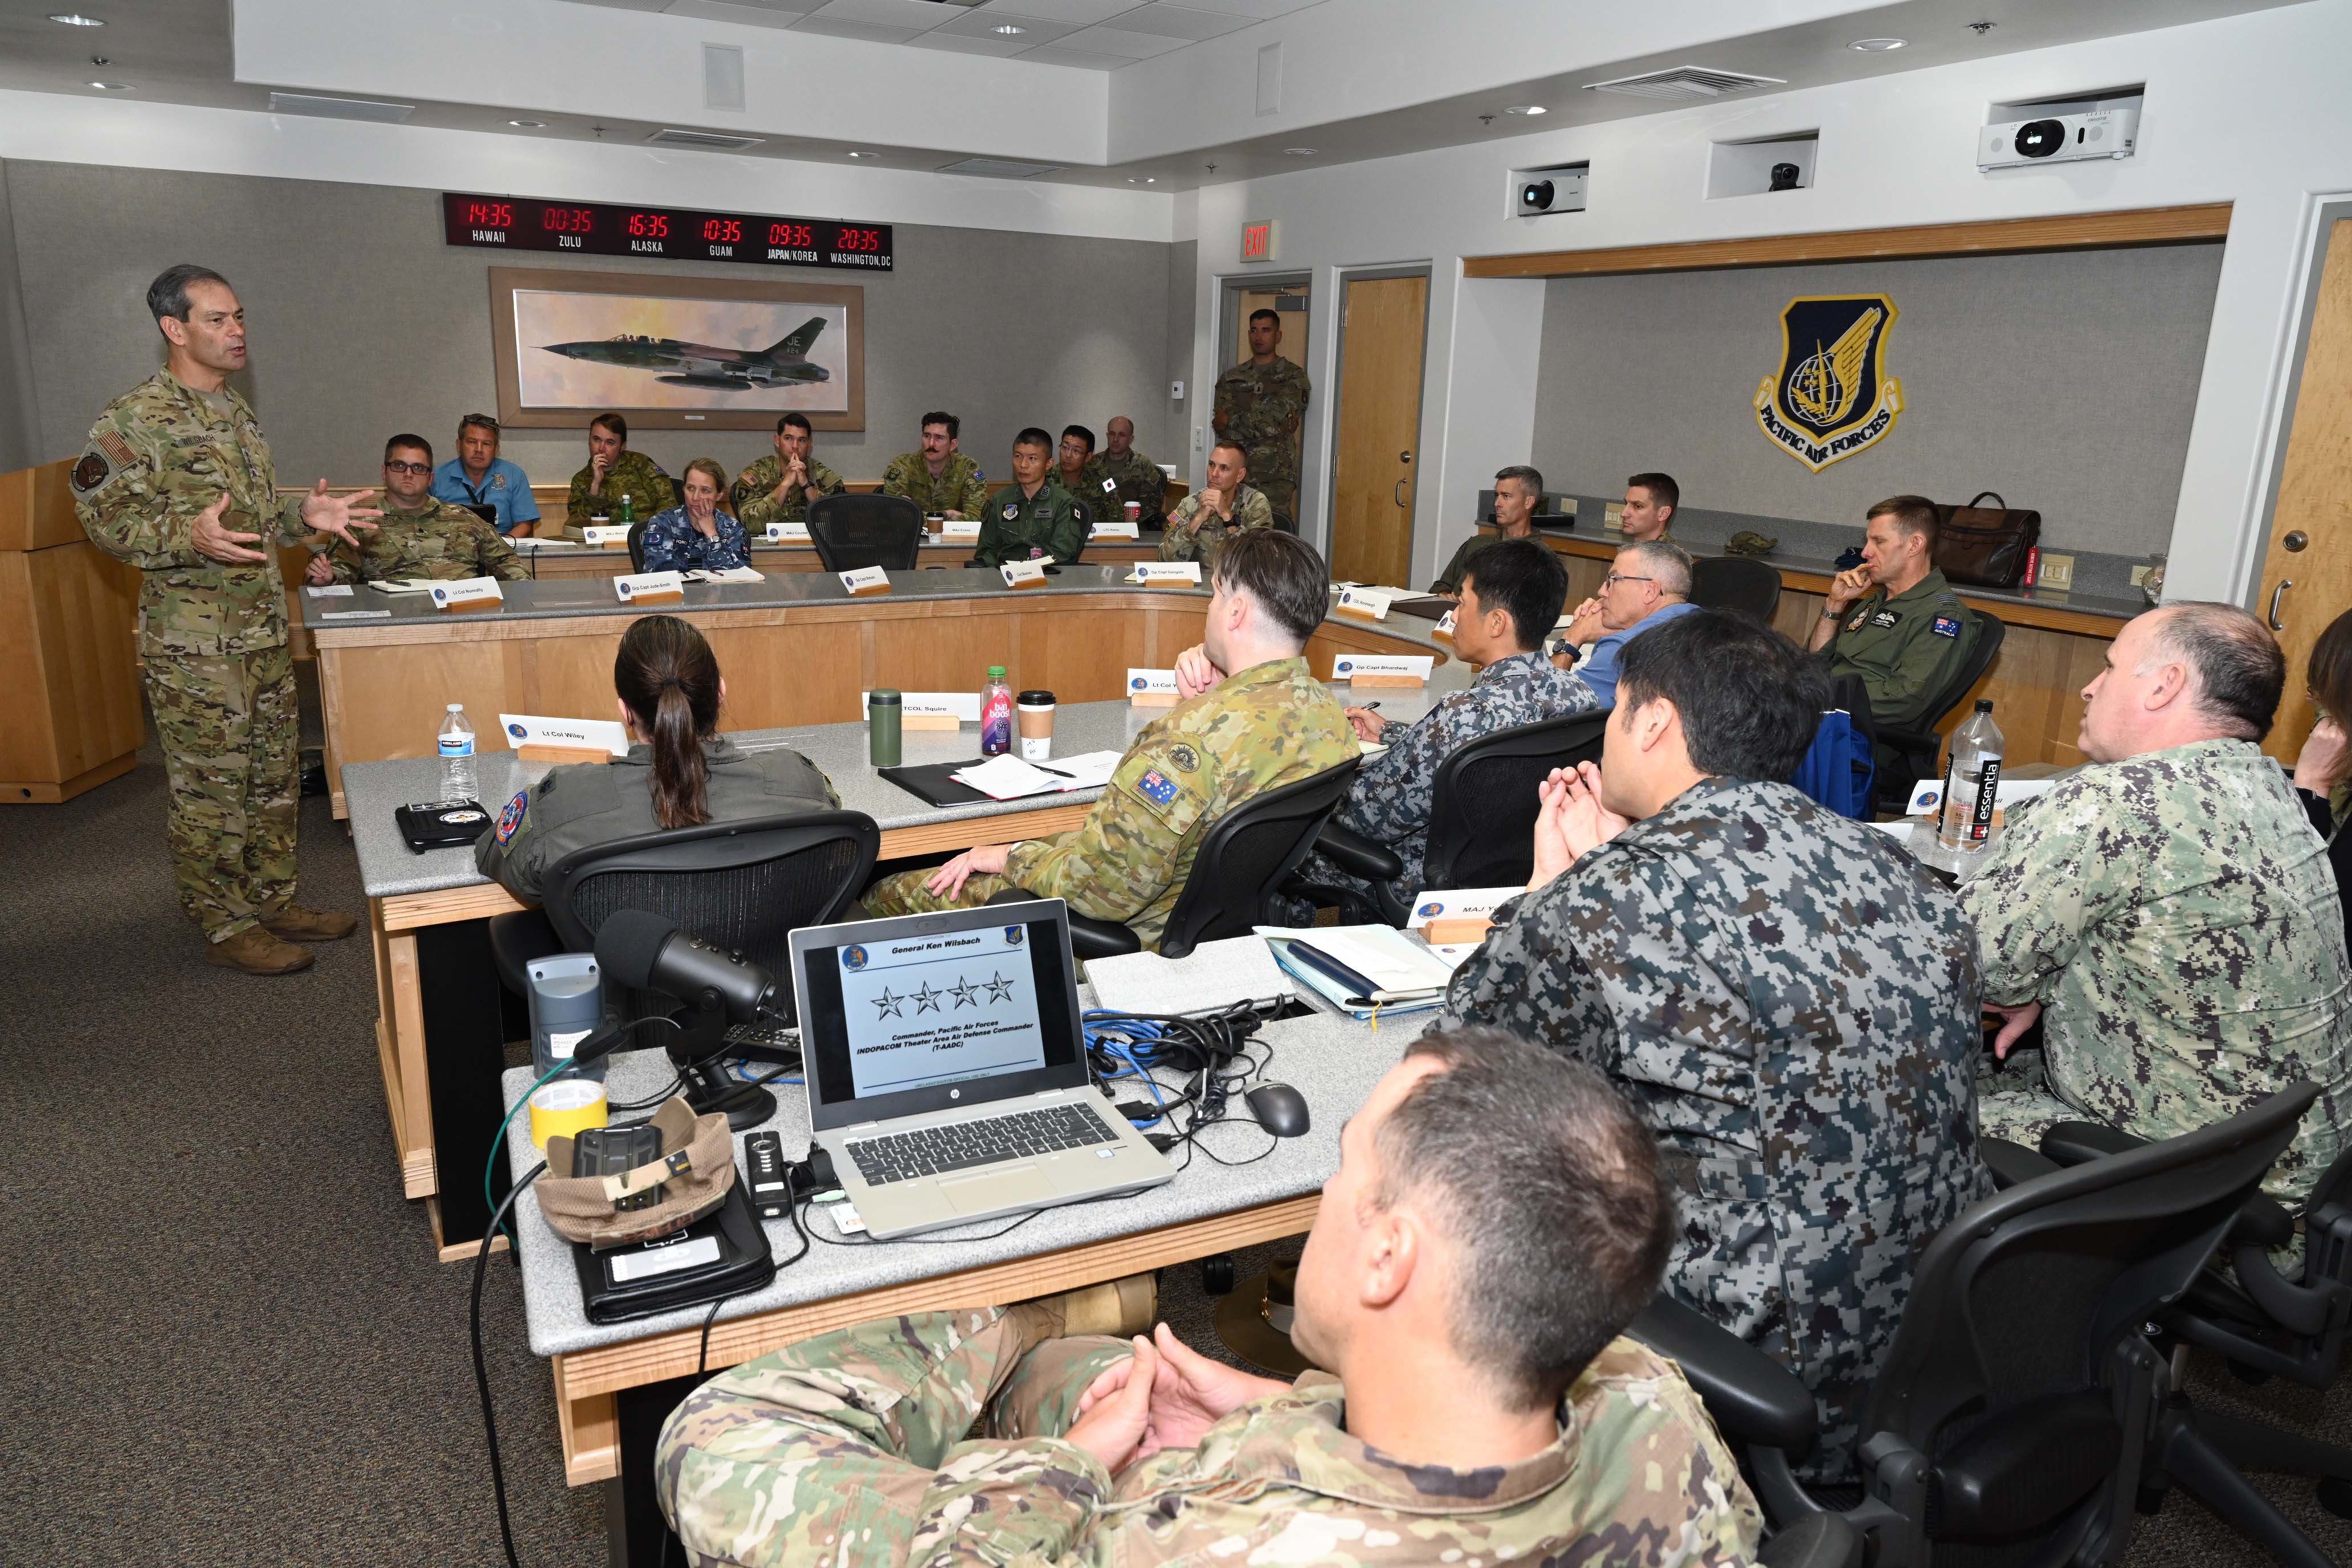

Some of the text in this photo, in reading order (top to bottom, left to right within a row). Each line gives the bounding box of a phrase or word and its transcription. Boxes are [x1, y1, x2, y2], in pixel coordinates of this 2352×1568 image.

[469, 204, 511, 226] 14:35
[544, 208, 591, 231] 00:35
[629, 215, 668, 236] 16:35
[704, 220, 741, 242] 10:35
[769, 224, 811, 246] 09:35
[472, 230, 505, 243] HAWAII
[559, 235, 581, 247] ZULU
[631, 240, 663, 252] ALASKA
[838, 229, 879, 251] 20:35
[1246, 226, 1267, 255] EXIT
[709, 245, 732, 257] GUAM
[767, 249, 818, 262] JAPAN/KOREA
[787, 336, 801, 346] JE
[1761, 405, 1891, 463] PACIFIC AIR FORCES
[1934, 628, 1955, 637] AUSTRALIA
[990, 709, 1010, 718] boost
[995, 703, 1007, 711] bai
[1980, 764, 1998, 820] essentia
[892, 944, 924, 954] General
[945, 937, 981, 947] Wilsbach
[856, 1043, 901, 1055] INDOPACOM
[904, 1038, 931, 1047] Theater
[963, 1030, 991, 1038] Defense
[993, 1023, 1034, 1034] Commander
[892, 1030, 936, 1041] Commander,
[938, 1026, 962, 1034] Pacific
[975, 1020, 999, 1028] Forces
[932, 1041, 964, 1052] (T-AADC)
